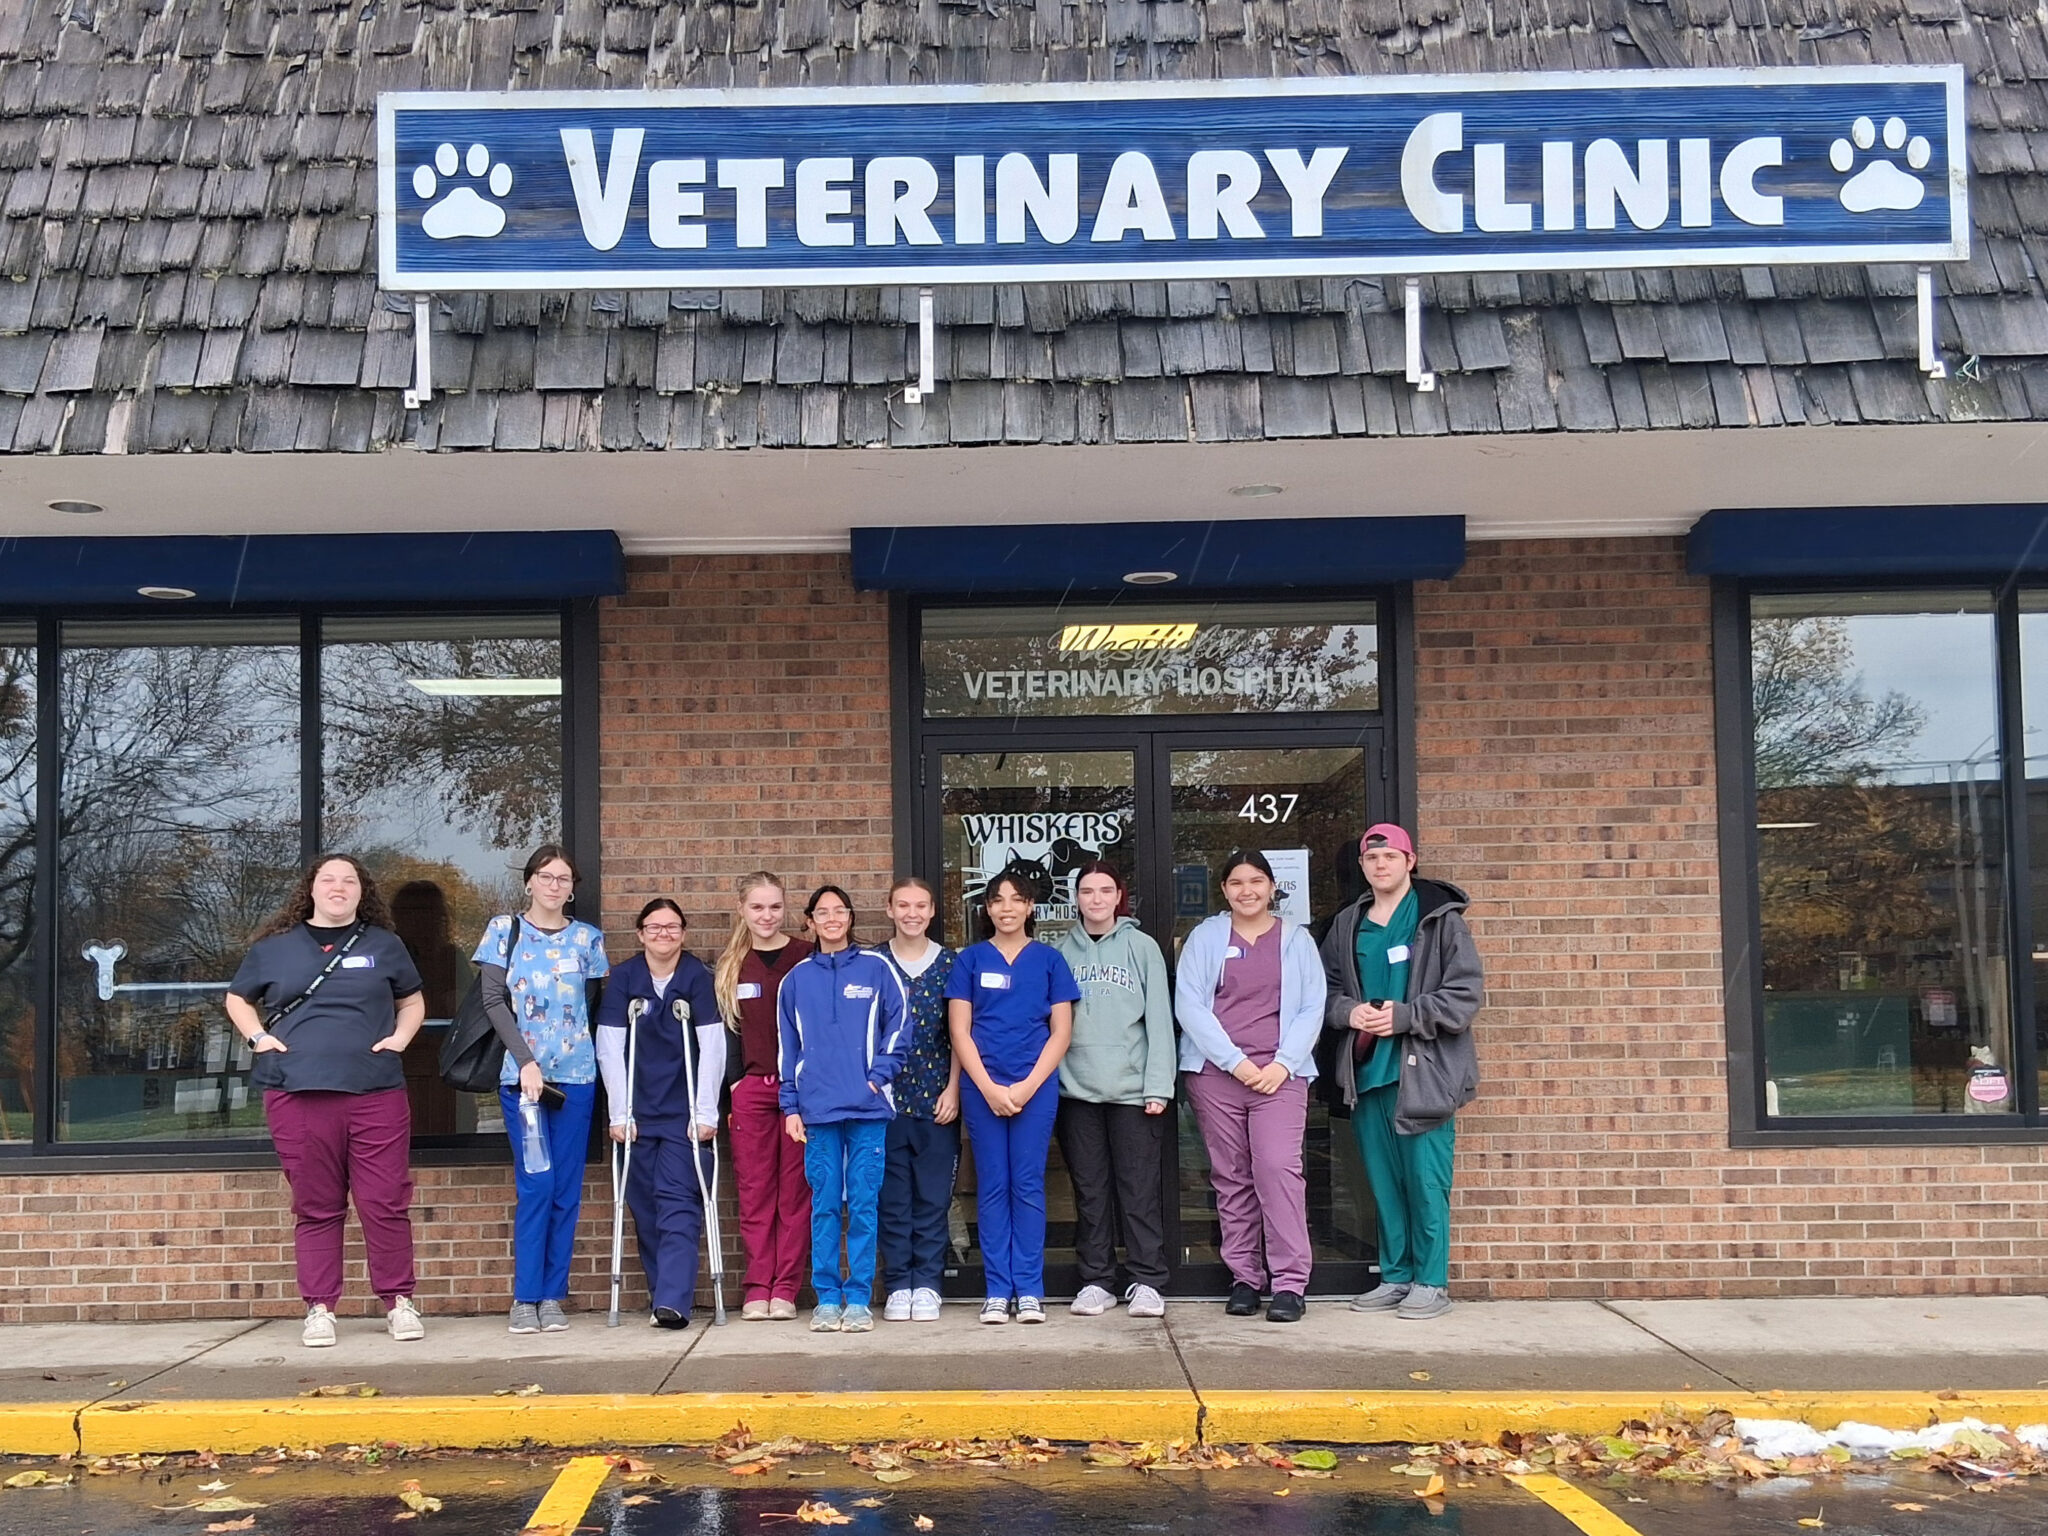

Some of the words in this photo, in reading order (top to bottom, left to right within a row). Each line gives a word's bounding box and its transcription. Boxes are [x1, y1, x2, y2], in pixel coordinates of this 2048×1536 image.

[559, 128, 1349, 251] VETERINARY
[1400, 111, 1785, 234] CLINIC
[963, 669, 1166, 699] VETERINARY
[1177, 666, 1332, 696] HOSPITAL
[1237, 793, 1299, 824] 437
[961, 812, 1122, 846] WHISKERS
